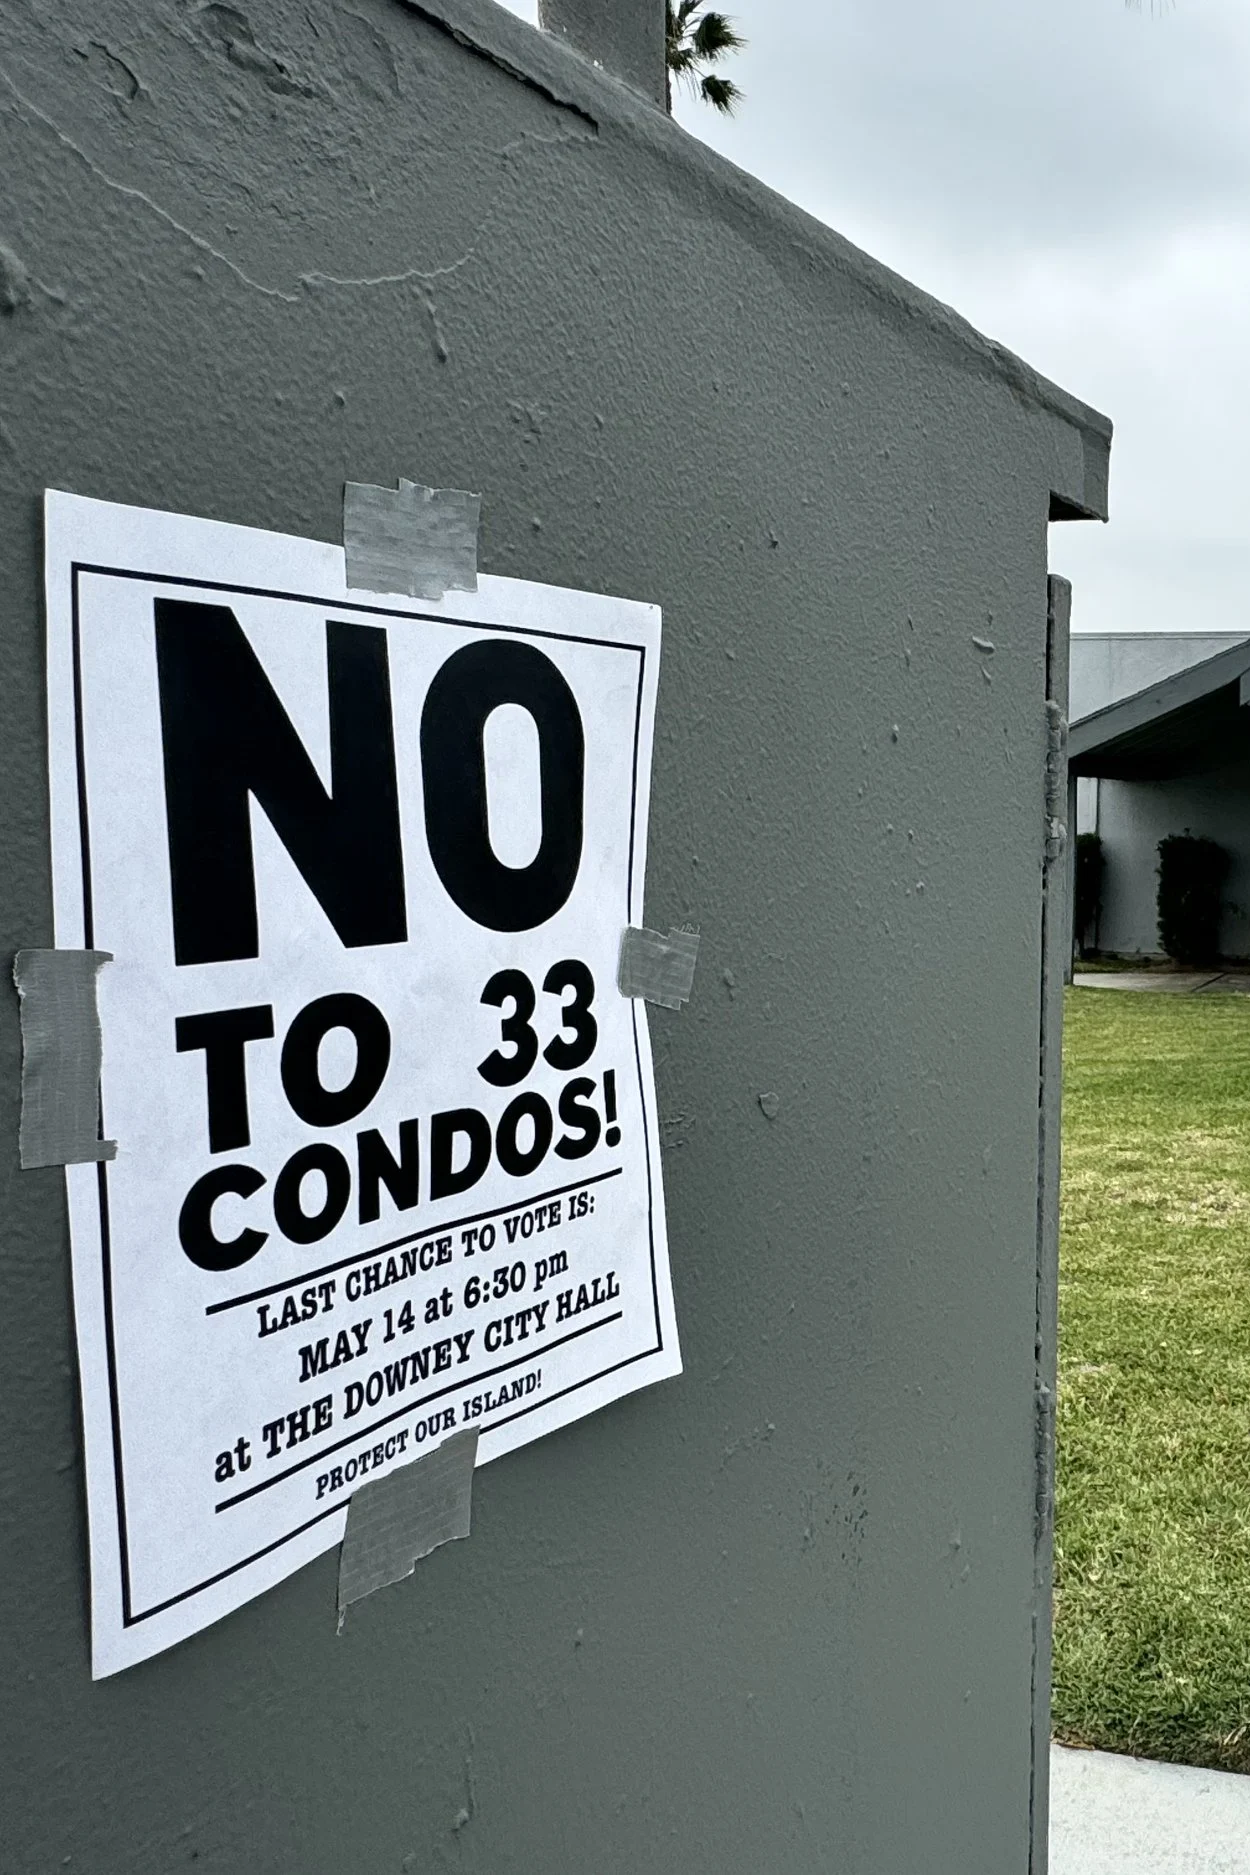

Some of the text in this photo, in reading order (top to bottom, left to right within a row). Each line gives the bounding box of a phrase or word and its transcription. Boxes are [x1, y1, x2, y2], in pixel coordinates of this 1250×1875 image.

[154, 597, 584, 966] NO
[176, 959, 597, 1154] TO 33
[179, 1069, 621, 1271] CONDOS!
[257, 1191, 595, 1338] LAST CHANCE TO VOTE IS:
[215, 1271, 619, 1482] at THE DOWNEY CITY HALL
[299, 1250, 569, 1382] MAY 14 at 6:30 pm
[315, 1369, 542, 1500] PROTECT OUR ISLAND!
